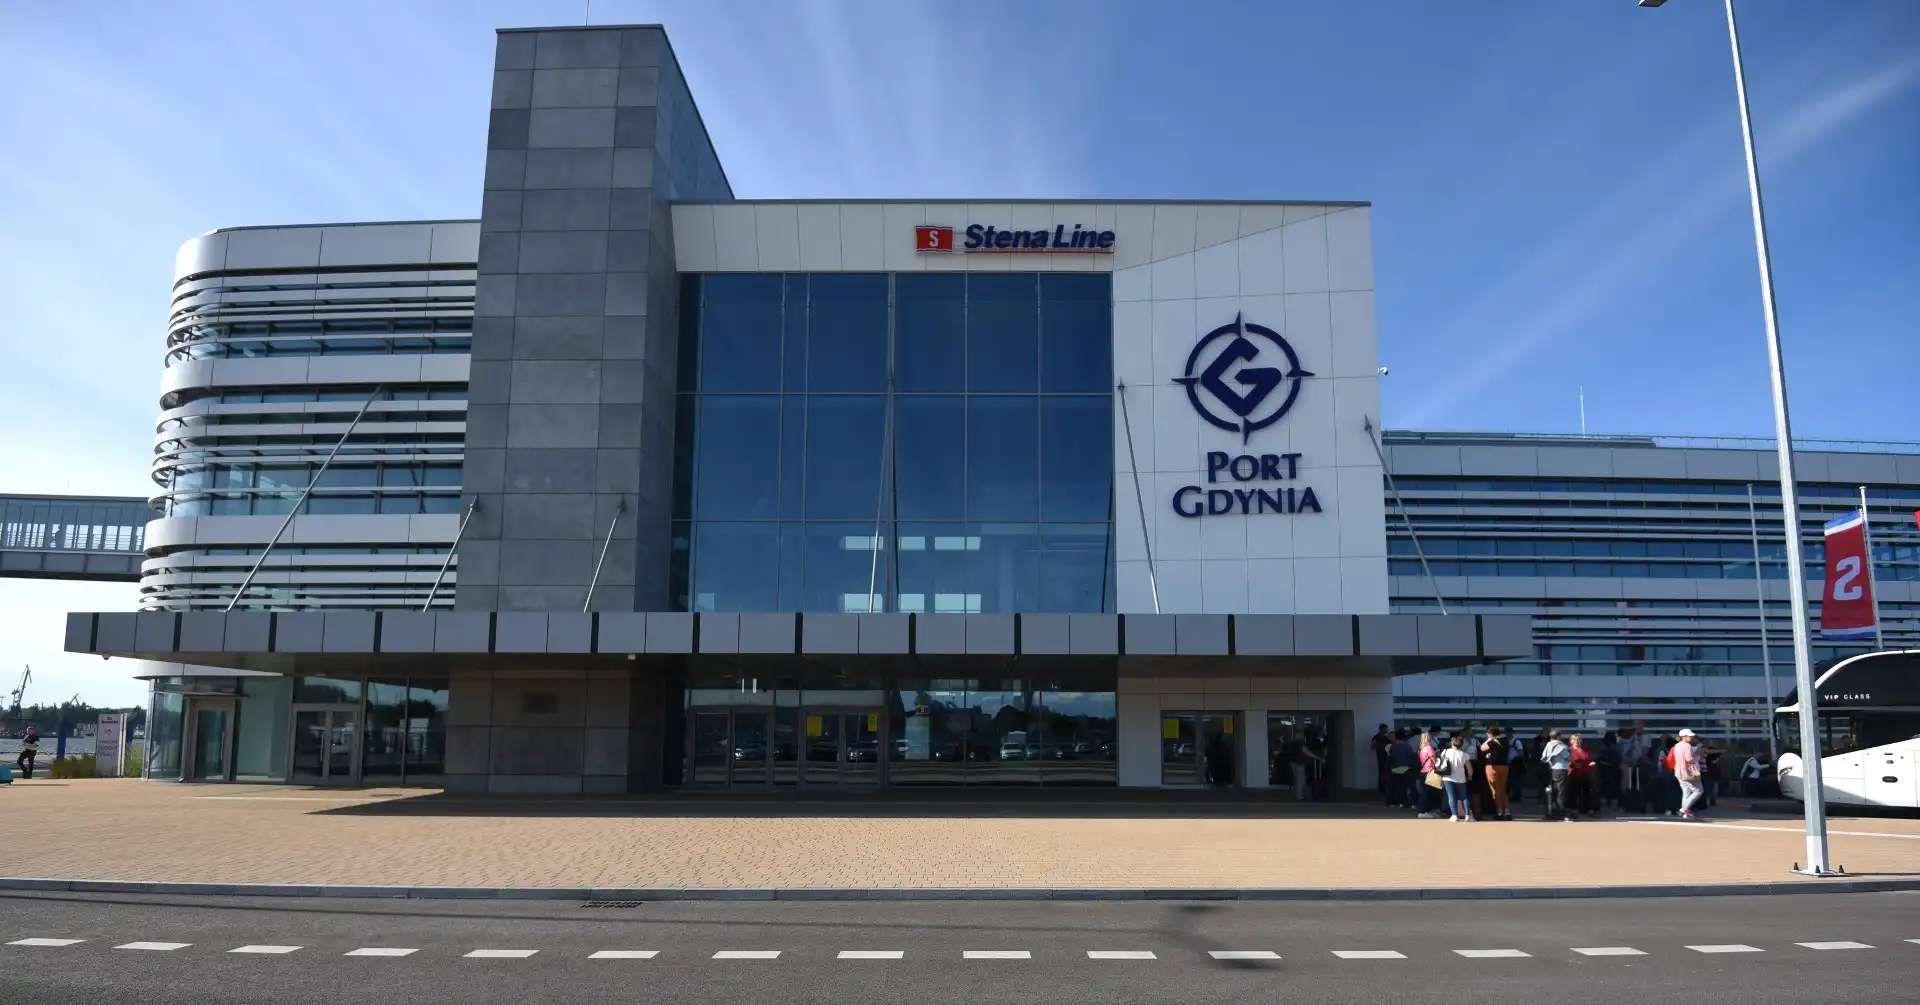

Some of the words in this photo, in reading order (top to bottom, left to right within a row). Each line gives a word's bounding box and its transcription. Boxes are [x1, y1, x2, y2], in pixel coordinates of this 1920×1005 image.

[929, 230, 939, 247] S
[964, 223, 1049, 249] Stena
[1053, 223, 1116, 248] Line
[1207, 451, 1302, 483] PORT
[1172, 485, 1323, 518] GDYNIA
